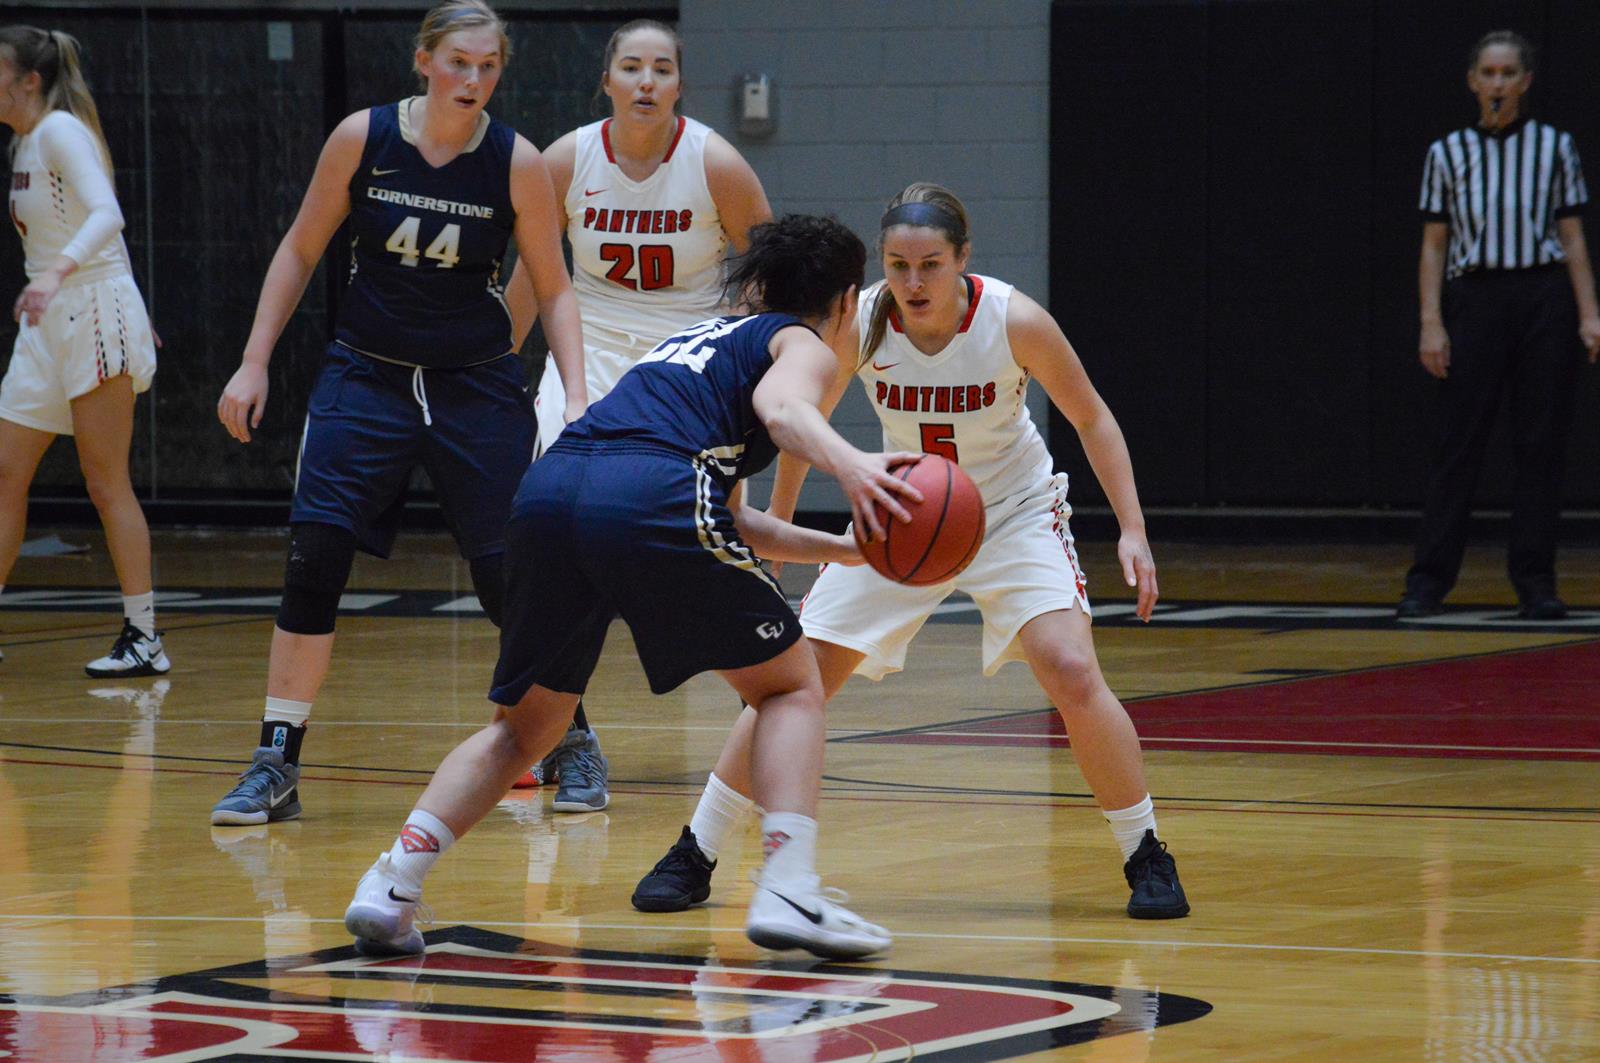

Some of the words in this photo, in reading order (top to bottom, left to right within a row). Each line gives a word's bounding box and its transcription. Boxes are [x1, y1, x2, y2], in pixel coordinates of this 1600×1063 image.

[367, 186, 494, 219] CORNERSTONE
[583, 207, 693, 234] PANTHERS
[384, 216, 460, 269] 44
[600, 243, 675, 291] 20
[876, 380, 996, 413] PANTHERS
[919, 423, 959, 465] 5
